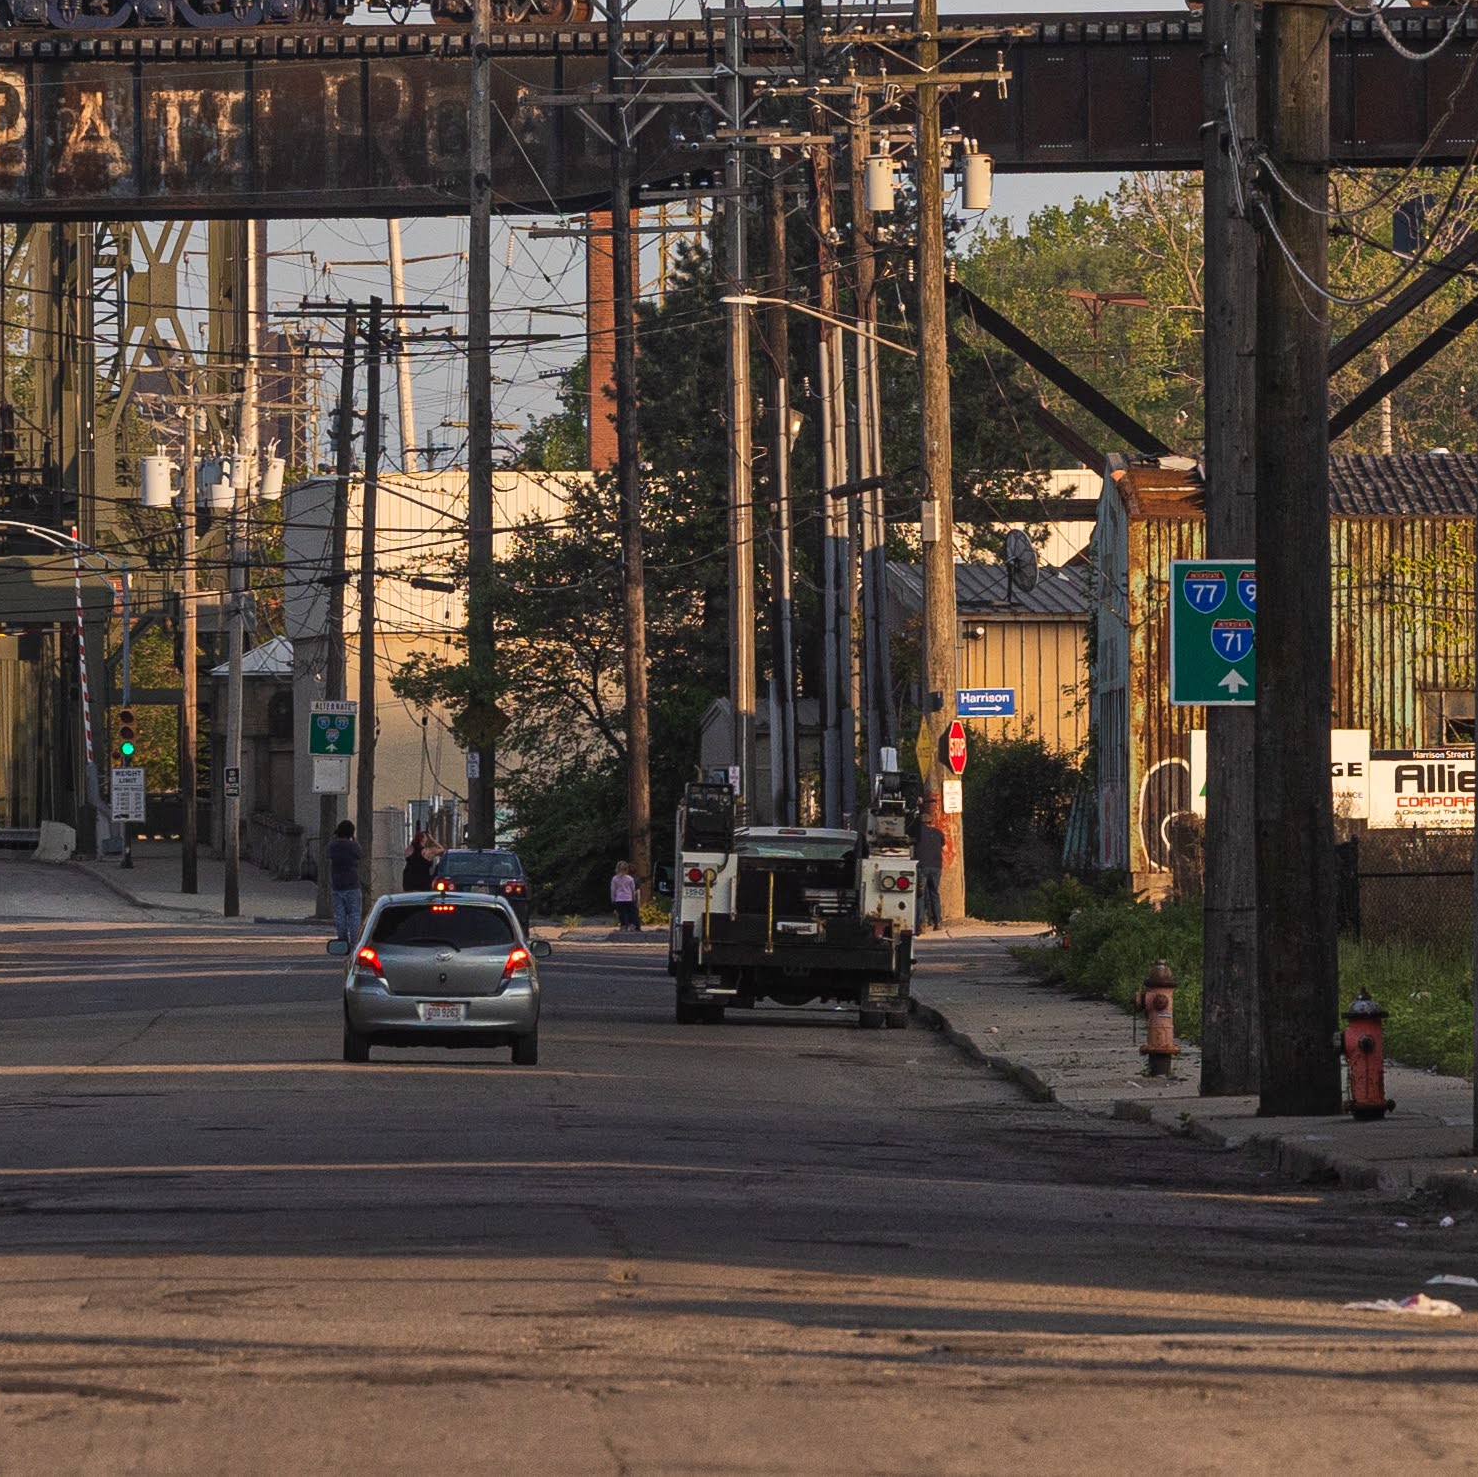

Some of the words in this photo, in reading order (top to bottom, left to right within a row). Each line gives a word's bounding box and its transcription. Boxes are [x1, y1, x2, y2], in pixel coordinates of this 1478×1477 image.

[1192, 584, 1218, 603] 77
[1222, 633, 1242, 652] 71
[960, 693, 1010, 703] Harrison
[949, 738, 966, 757] STOP
[1412, 751, 1445, 759] Harrison
[1394, 764, 1476, 793] Allie
[1397, 797, 1476, 808] CORPORA
